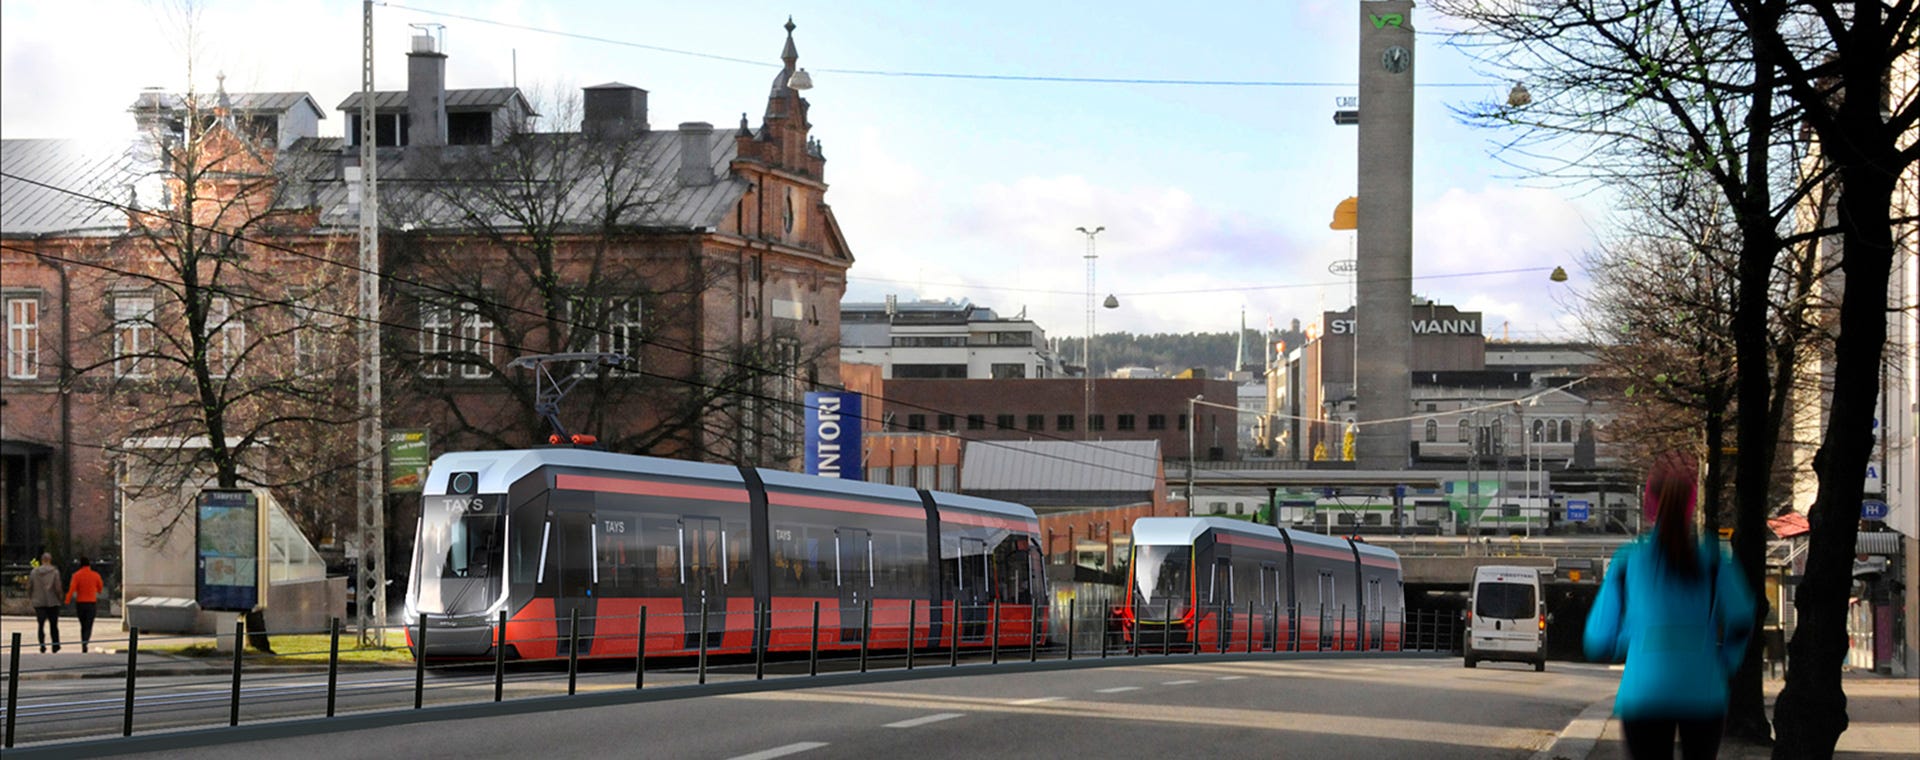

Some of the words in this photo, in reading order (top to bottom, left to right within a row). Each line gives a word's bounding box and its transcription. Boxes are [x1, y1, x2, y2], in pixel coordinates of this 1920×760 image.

[1369, 13, 1403, 29] VR
[442, 498, 484, 511] TAYS
[605, 520, 625, 533] TAYS
[776, 529, 792, 541] TAYS
